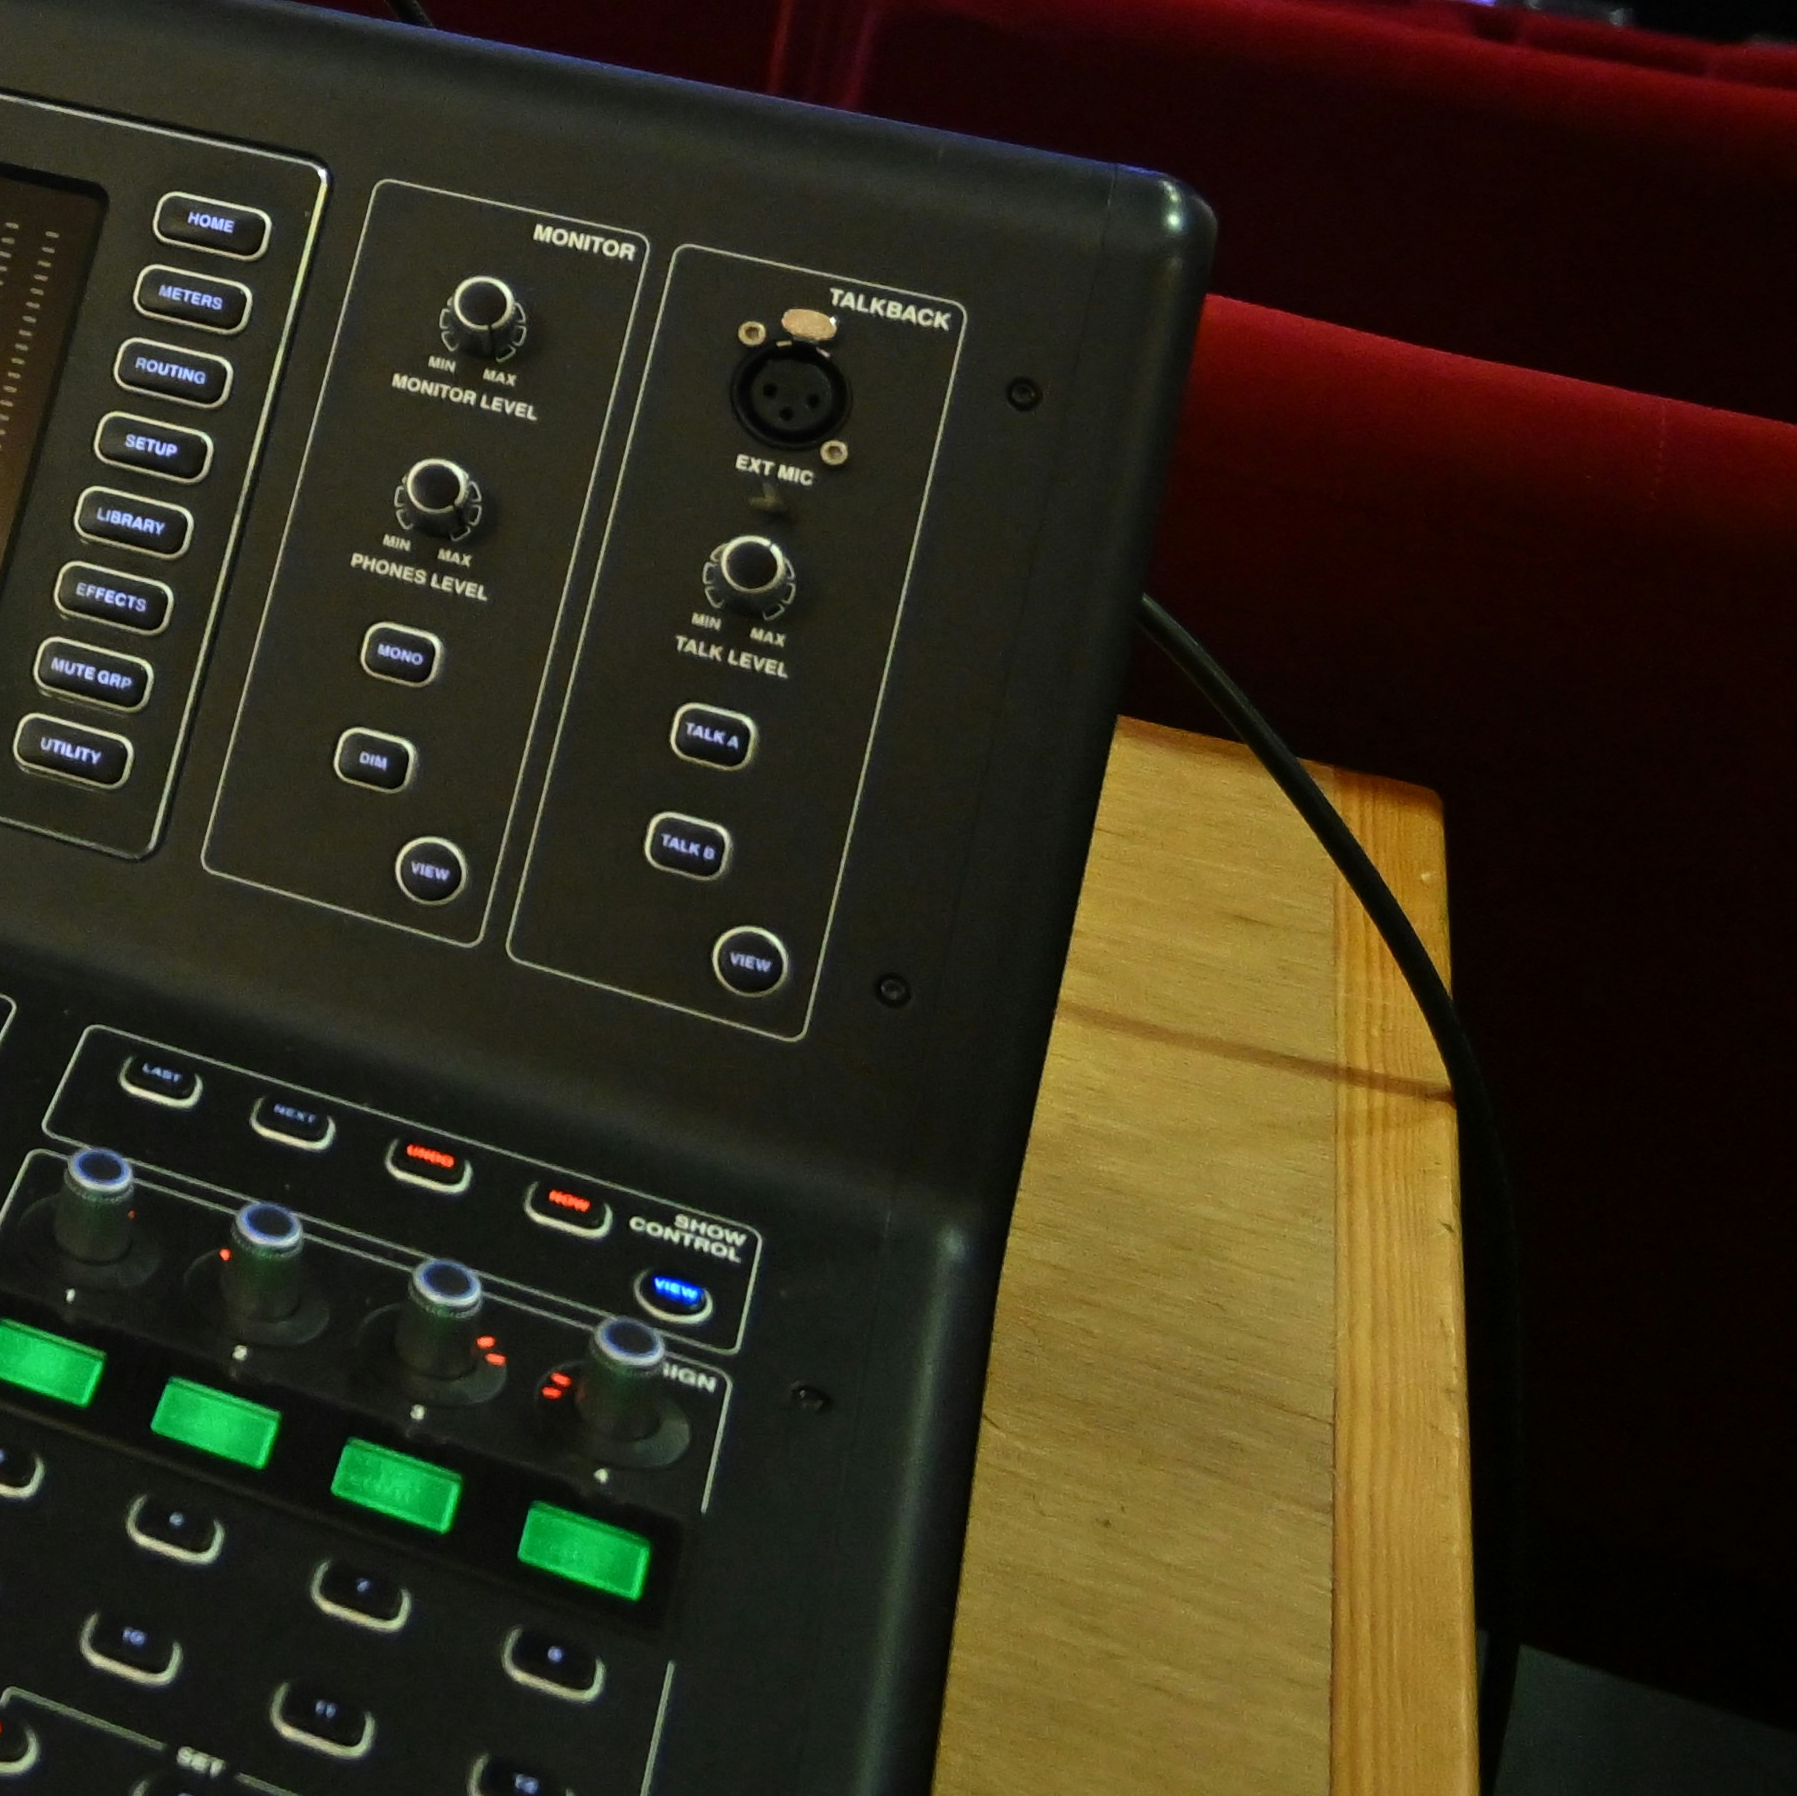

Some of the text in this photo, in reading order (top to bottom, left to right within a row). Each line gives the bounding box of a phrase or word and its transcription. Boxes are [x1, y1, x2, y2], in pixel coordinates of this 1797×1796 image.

[187, 211, 235, 234] HOME
[533, 223, 636, 261] MONITOR
[158, 284, 223, 310] METERS
[829, 287, 951, 331] TALKBACK
[135, 357, 206, 385] ROUTING
[427, 355, 457, 373] MIN
[482, 368, 517, 387] MAX
[391, 372, 538, 421] MONITOR LEVEL
[125, 434, 178, 457] SETUP
[735, 453, 814, 486] EXT MIC
[96, 507, 166, 535] LIBRARY
[382, 533, 411, 552] MIN
[437, 548, 472, 568] MAX
[350, 552, 488, 602] PHONES LEVEL
[75, 582, 147, 612] EFFECTS
[691, 612, 722, 631] MIN
[749, 627, 786, 648] MAX
[377, 643, 424, 666] MONO
[675, 635, 788, 679] TALK LEVEL
[50, 657, 133, 689] MUTE GRP
[686, 722, 739, 750] TALK A
[40, 737, 102, 765] UTILITY
[359, 751, 388, 770] DIM
[662, 833, 716, 860] TALK B
[411, 861, 450, 881] VIEW
[730, 952, 772, 973] VIEW
[142, 1063, 182, 1083] LAST
[273, 1103, 316, 1123] NEXT
[406, 1144, 455, 1168] UNDO
[548, 1189, 591, 1213] NOW
[628, 1216, 743, 1263] CONTROL
[674, 1213, 747, 1247] SHOW
[652, 1276, 700, 1301] VIEW
